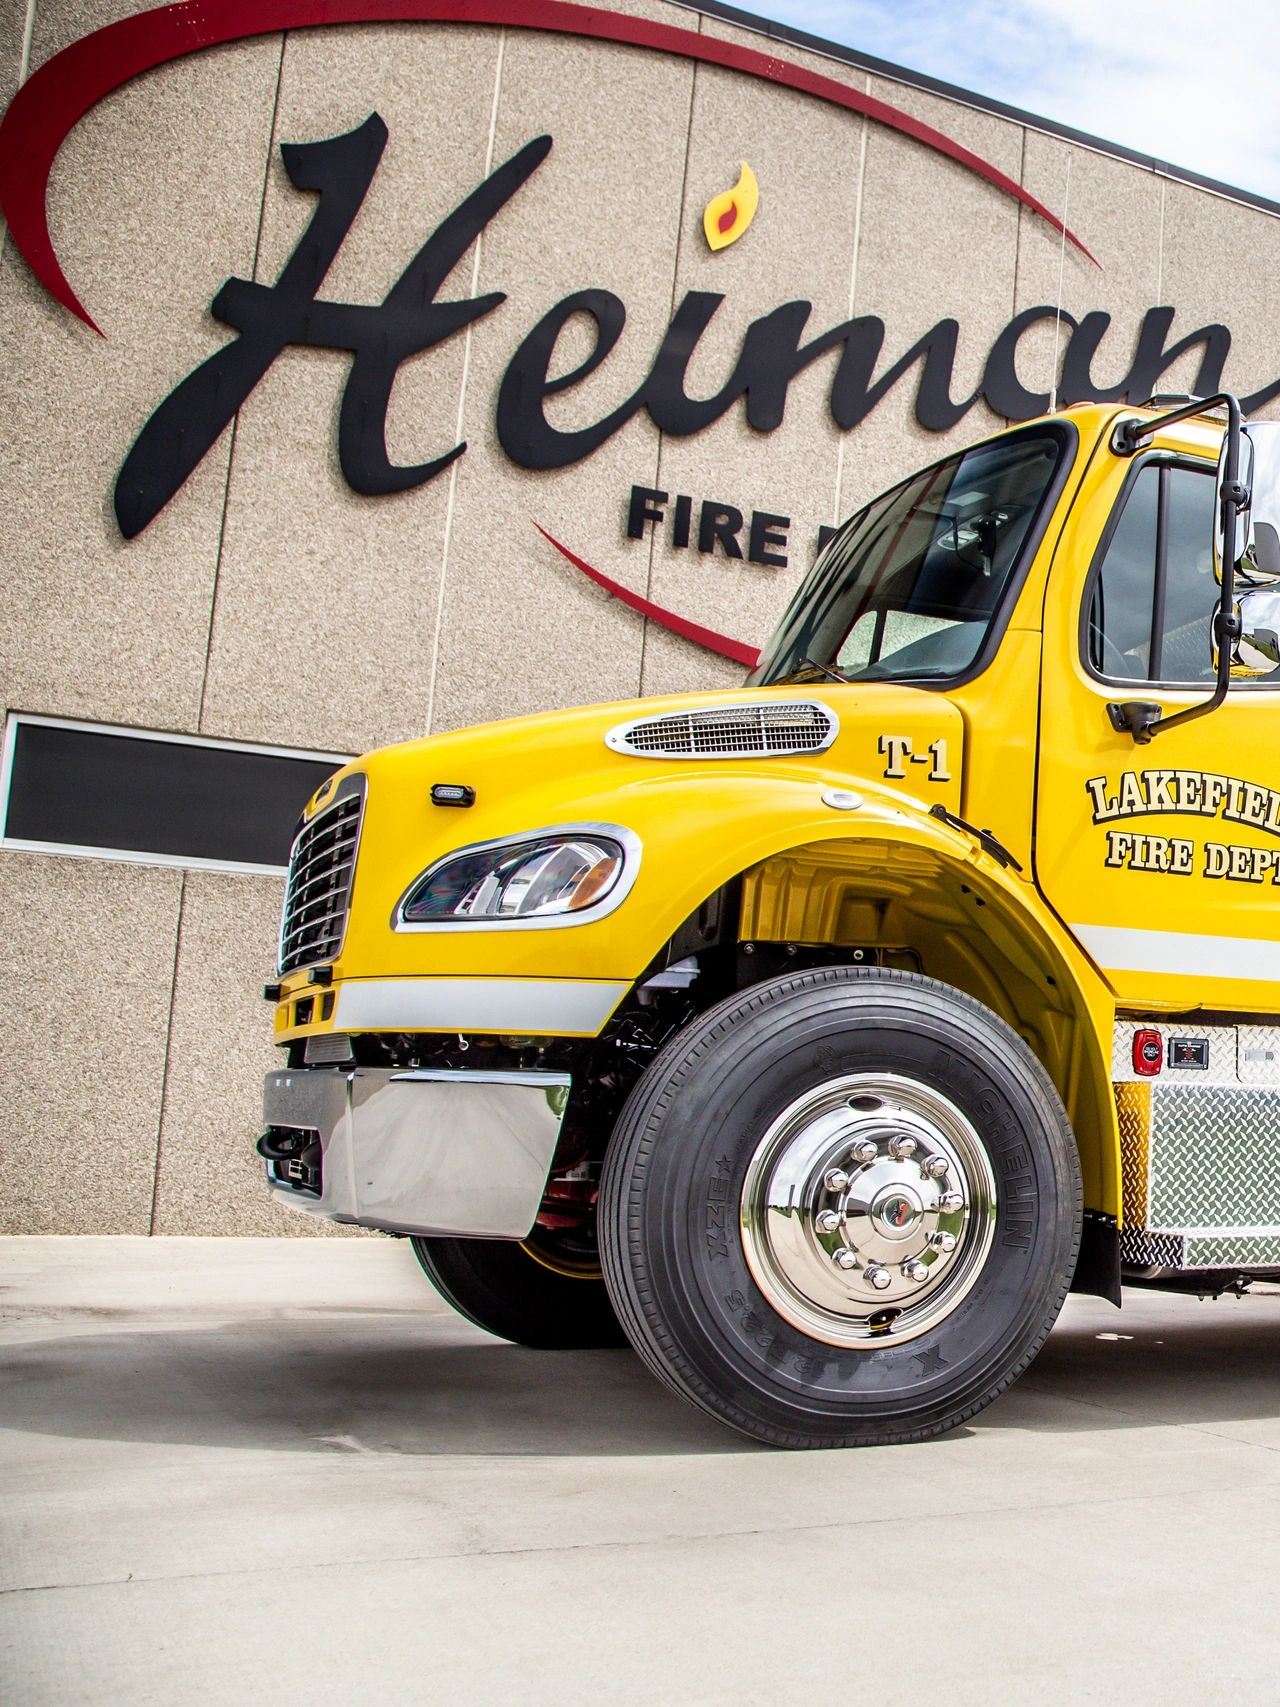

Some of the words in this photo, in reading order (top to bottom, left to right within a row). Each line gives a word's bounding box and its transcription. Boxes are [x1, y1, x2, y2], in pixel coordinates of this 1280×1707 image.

[627, 485, 791, 568] FIRE
[878, 735, 951, 782] T-1
[1105, 831, 1194, 874] FIRE
